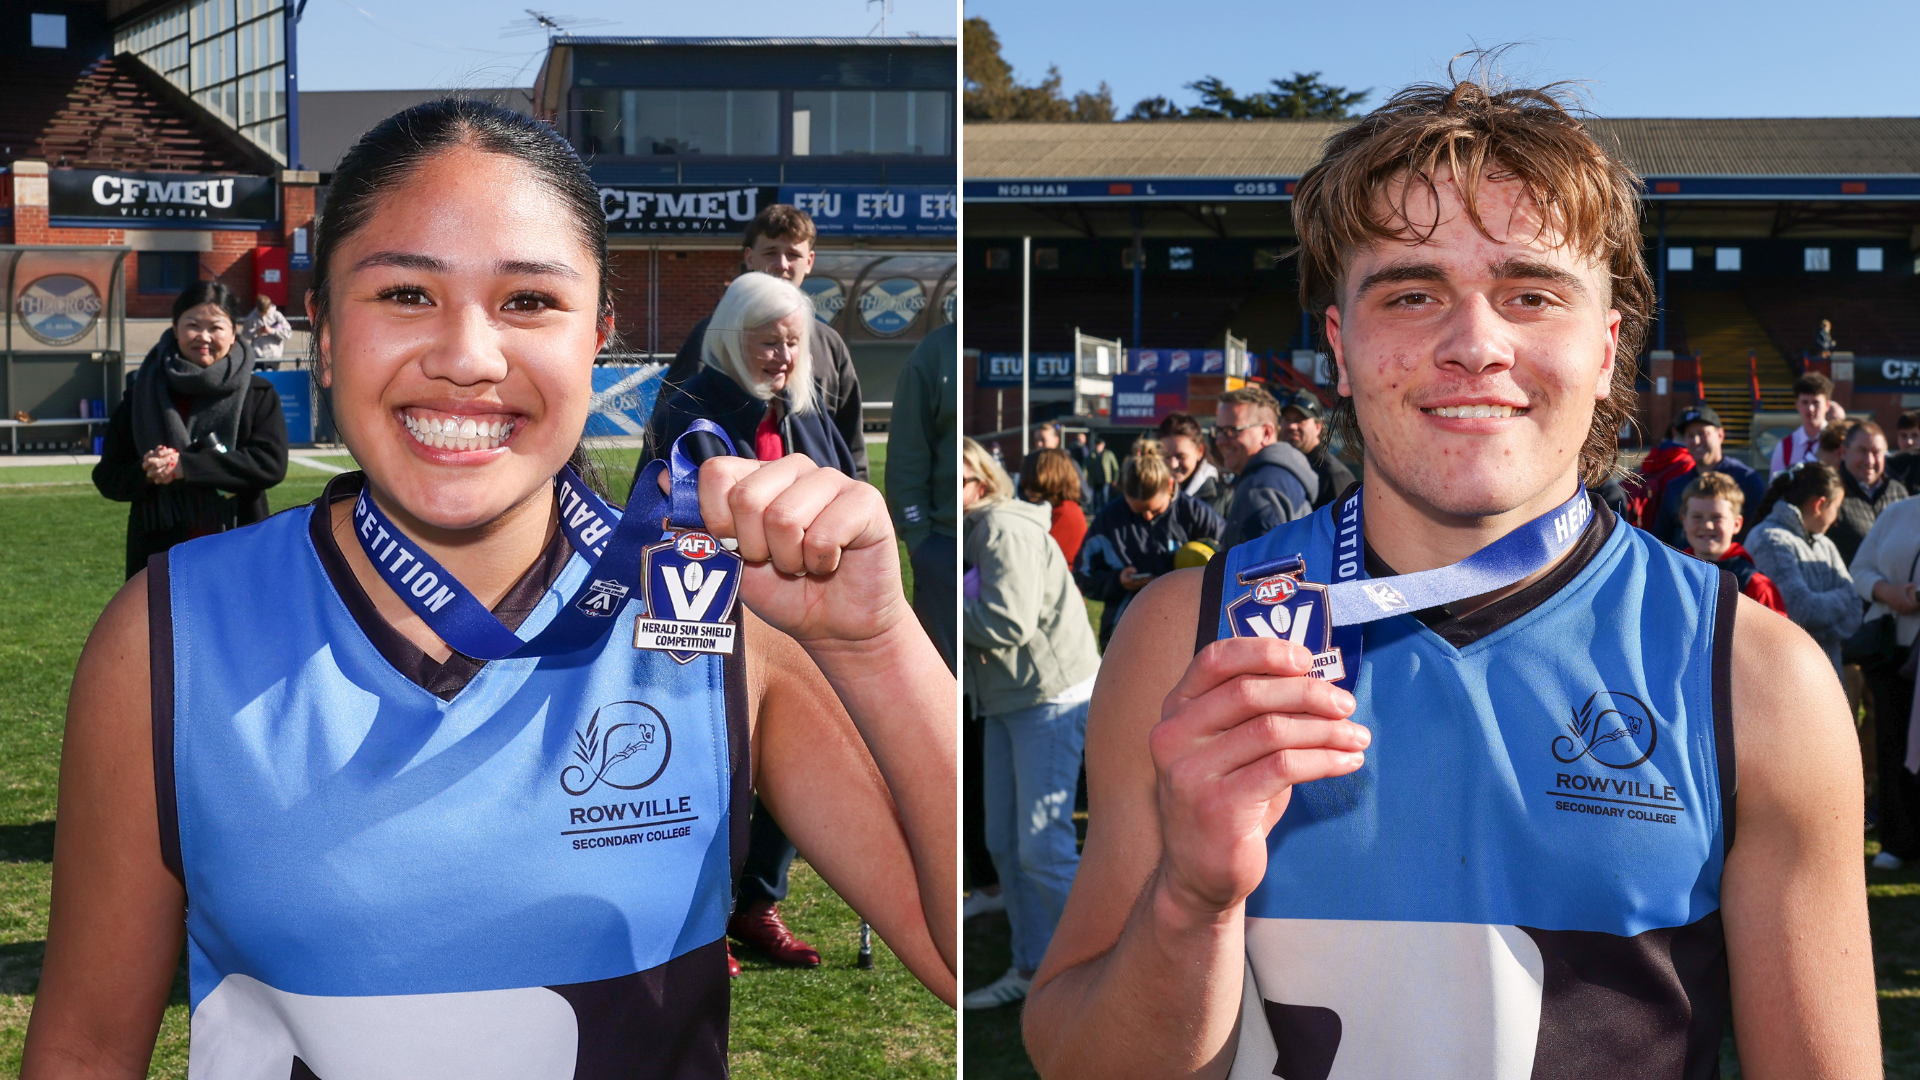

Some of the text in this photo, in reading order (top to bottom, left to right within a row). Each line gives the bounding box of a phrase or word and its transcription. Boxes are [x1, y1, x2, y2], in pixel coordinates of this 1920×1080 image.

[92, 174, 235, 209] CFMEU
[997, 182, 1277, 197] NORMAN L GOSS
[120, 207, 208, 218] VICTORIA
[600, 187, 759, 222] CFMEU
[794, 193, 842, 218] ETU
[857, 194, 905, 218] ETU
[624, 221, 727, 230] VICTORIA
[990, 356, 1024, 375] ETU
[1037, 356, 1070, 375] ETU
[1881, 359, 1920, 380] CF
[677, 537, 717, 554] AFL
[1339, 494, 1358, 581] ETITIO
[355, 487, 456, 613] PETITION
[1257, 581, 1296, 601] AFL
[641, 622, 732, 638] HERALD SUN SHIELD
[655, 635, 717, 649] COMPETITION
[1312, 654, 1338, 669] HIELD
[1556, 772, 1677, 802] ROWVILLE
[569, 796, 692, 825] ROWVILLE
[1555, 801, 1677, 825] SECONDARY COLLEGE
[572, 826, 691, 850] SECONDARY COLLEGE
